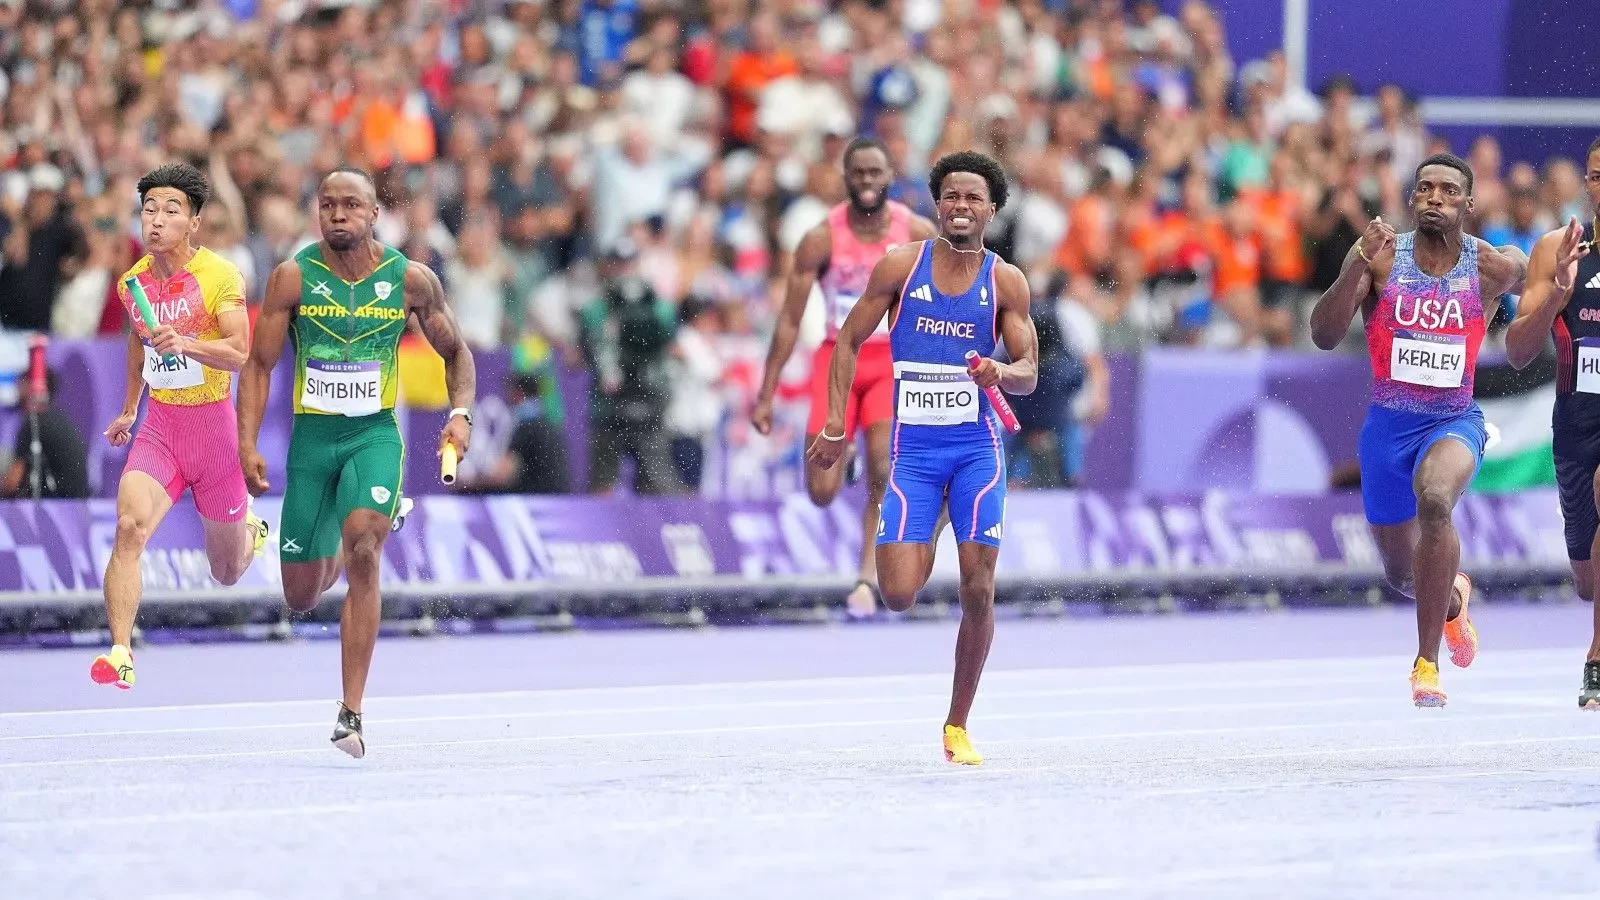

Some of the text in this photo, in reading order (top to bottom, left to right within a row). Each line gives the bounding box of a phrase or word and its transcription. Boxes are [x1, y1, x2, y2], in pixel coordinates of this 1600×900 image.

[299, 305, 406, 320] SOUTH AFRICA
[1395, 295, 1464, 329] USA
[916, 316, 975, 338] FRANCE
[1412, 332, 1432, 340] PARIS
[1398, 348, 1460, 371] KERLEY
[306, 378, 377, 398] SIMBINE
[906, 391, 972, 408] MATEO
